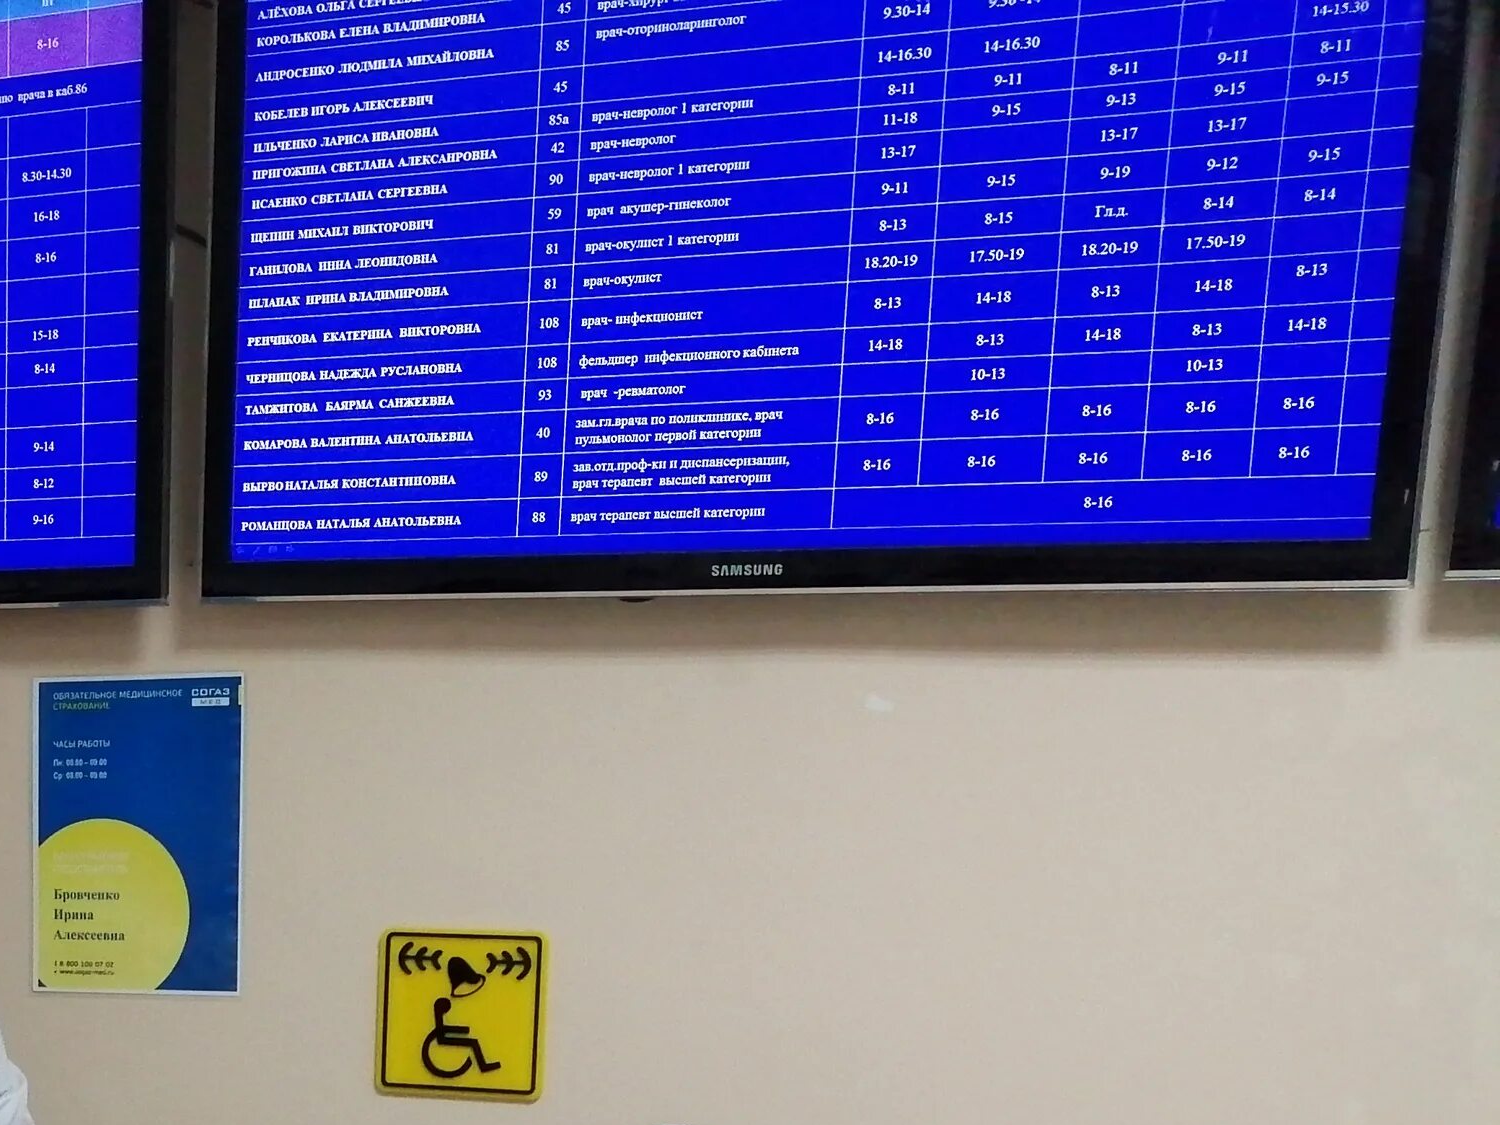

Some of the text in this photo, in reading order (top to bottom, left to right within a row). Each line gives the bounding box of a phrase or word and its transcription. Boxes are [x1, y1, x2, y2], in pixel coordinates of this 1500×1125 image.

[257, 13, 485, 47] КОРОЛЬКОВА ЕЛЕНА ВЛАДИМИРОВНА
[37, 37, 59, 49] 8-16
[556, 40, 569, 51] 85
[984, 36, 1040, 53] 14-16.30
[878, 47, 932, 63] 14-16.30
[1218, 49, 1248, 65] 9-11
[255, 49, 494, 82] АНДРОСЕНКО ЛЮДМИЛА МИХАЙЛОВНА
[994, 73, 1021, 87] 9-11
[888, 82, 914, 96] 8-11
[1214, 81, 1246, 96] 9-15
[18, 91, 46, 103] врача
[47, 90, 53, 98] в
[1106, 93, 1136, 107] 9-13
[254, 95, 433, 121] КОБЕЛЕВ ИГОРЬ АЛЕКСЕЕВИЧ
[592, 99, 753, 124] врач-невролог 1 категории
[992, 103, 1021, 117] 9-15
[549, 114, 569, 126] 85а
[884, 112, 918, 126] 11-18
[253, 127, 439, 153] ИЛЬЧЕНКО ЛАРИСА ИВАНОВНА
[1101, 127, 1138, 142] 13-17
[551, 142, 564, 153] 42
[590, 135, 676, 152] врач-невролог
[252, 165, 327, 180] ПРИГОЖИНА
[331, 159, 394, 173] СВЕТЛАНА
[1207, 156, 1238, 171] 9-12
[22, 167, 72, 182] 8.30-14.30
[549, 173, 563, 185] 90
[1100, 166, 1130, 179] 9-19
[252, 184, 448, 209] ИСАЕНКО СВЕТЛАНА СЕРГЕЕВНА
[548, 208, 562, 220] 59
[587, 198, 732, 219] врач акушер-гинеколог
[34, 210, 60, 222] 16-18
[984, 212, 1013, 225] 8-15
[298, 226, 349, 239] МИХАИЛ
[352, 219, 433, 235] ВИКТОРОВИЧ
[1082, 241, 1138, 256] 18.20-19
[1187, 234, 1246, 250] 17.50-19
[865, 254, 918, 269] 18.20-19
[970, 248, 1024, 263] 17.50-19
[583, 274, 662, 289] врач-окулист
[976, 291, 1011, 304] 14-18
[540, 317, 559, 329] 108
[1288, 317, 1327, 331] 14-18
[323, 329, 393, 342] ЕКАТЕРИНА
[399, 323, 481, 338] ВИКТОРОВНА
[579, 345, 799, 369] фельдшер инфекционного кабинета
[971, 368, 1005, 381] 10-13
[580, 389, 607, 401] врач
[325, 399, 374, 411] БАЯРМА
[379, 395, 455, 408] САНЖЕЕВНА
[866, 412, 894, 425] 8-16
[536, 427, 550, 438] 40
[243, 431, 474, 450] КОМАРОВА ВАЛЕНТИНА АНАТОЛЬЕВНА
[1278, 446, 1310, 459] 8-16
[285, 479, 339, 490] НАТАЛЬЯ
[342, 475, 456, 489] КОНСТАНТИНОВНА
[1084, 496, 1113, 508] 8-16
[33, 514, 54, 525] 9-16
[532, 512, 546, 523] 88
[570, 508, 765, 524] врач терапевт высшей категории
[241, 516, 461, 531] РОМАНЦОВА НАТАЛЬЯ АНАТОЛЬЕВНА
[711, 564, 783, 576] SAMSUNG
[52, 689, 183, 701] ОБЯЗАТЕЛЬНОЕ МЕДИЦИНСКОЕ
[191, 687, 230, 697] СОГАЗ
[52, 739, 111, 748] ЧАСЫ РАБОТЫ
[53, 888, 120, 903] Бровченко
[53, 909, 94, 923] Ирина
[53, 929, 125, 941] Алексеевна
